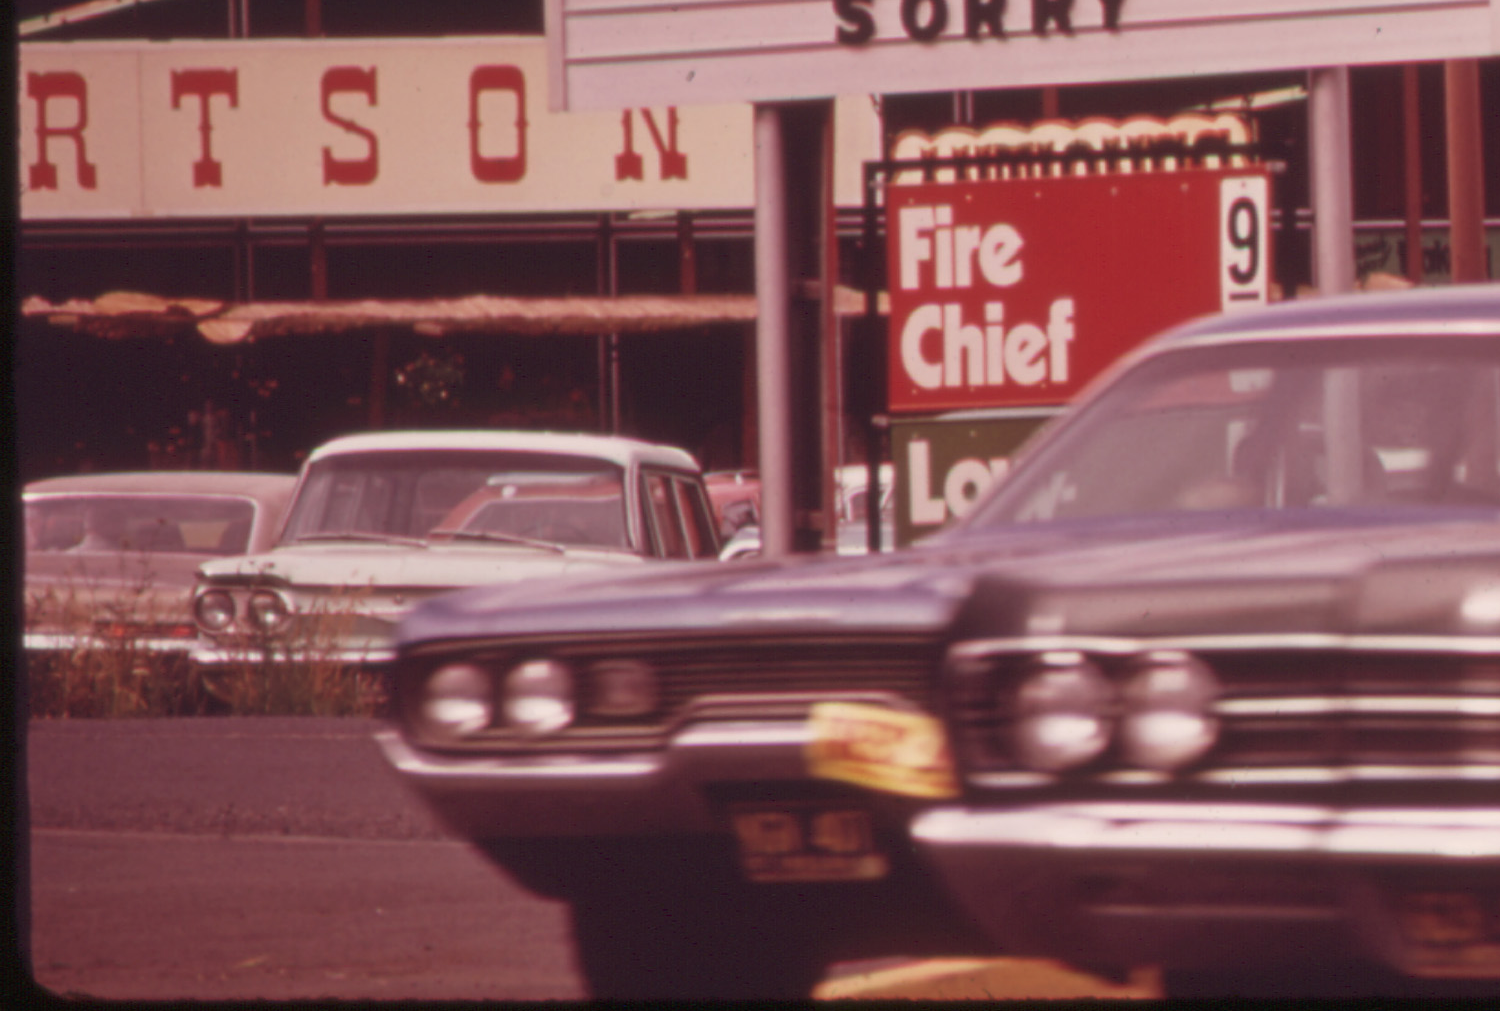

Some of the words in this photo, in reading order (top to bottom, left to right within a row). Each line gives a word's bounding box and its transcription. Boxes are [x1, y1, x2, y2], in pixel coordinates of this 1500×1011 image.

[900, 204, 1024, 289] Fire
[1228, 196, 1260, 285] 9
[901, 296, 1075, 389] Chief
[908, 440, 1010, 525] Lo
